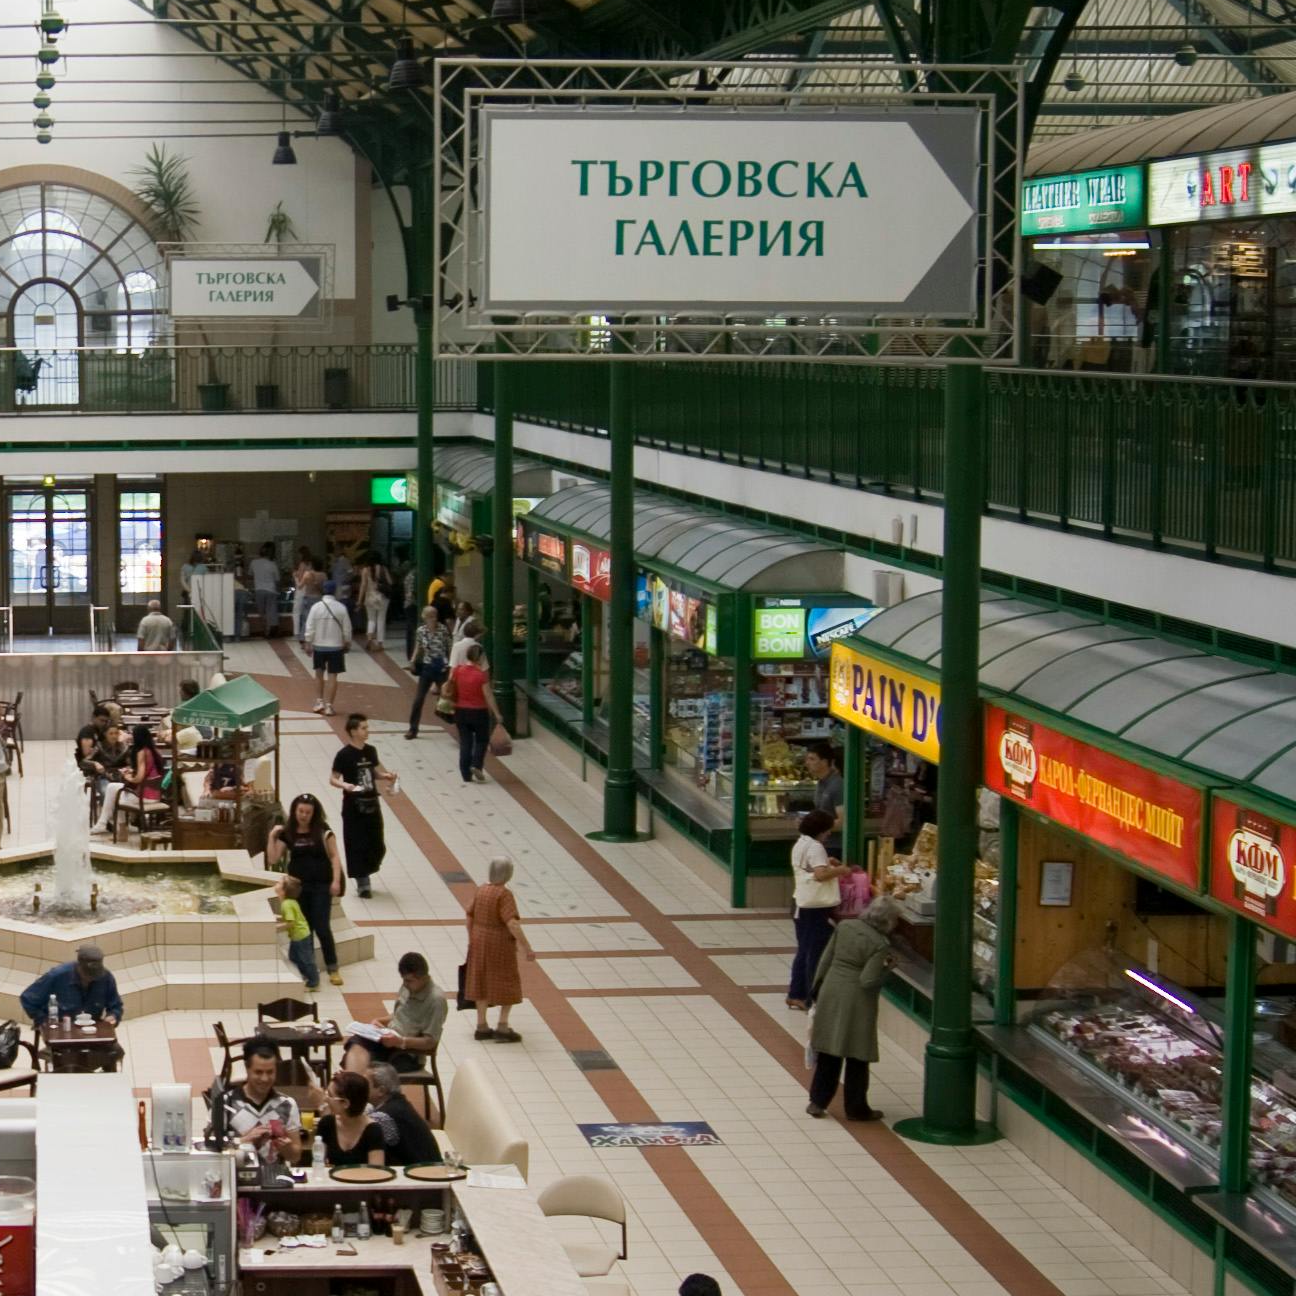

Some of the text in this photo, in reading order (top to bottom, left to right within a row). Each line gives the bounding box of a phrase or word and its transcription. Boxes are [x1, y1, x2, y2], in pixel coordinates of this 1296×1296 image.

[570, 159, 870, 199] ТЪРГОВСКА
[1200, 162, 1253, 207] ART
[614, 219, 826, 257] ГАЛЕРИЯ
[195, 271, 287, 285] ТЪРГОВСКА
[208, 290, 275, 303] ГАЛЕРИЯ
[760, 613, 801, 630] BON
[758, 637, 801, 653] BONI
[852, 664, 906, 732] PAIN
[911, 688, 943, 745] D'
[1235, 838, 1279, 881] КФМ
